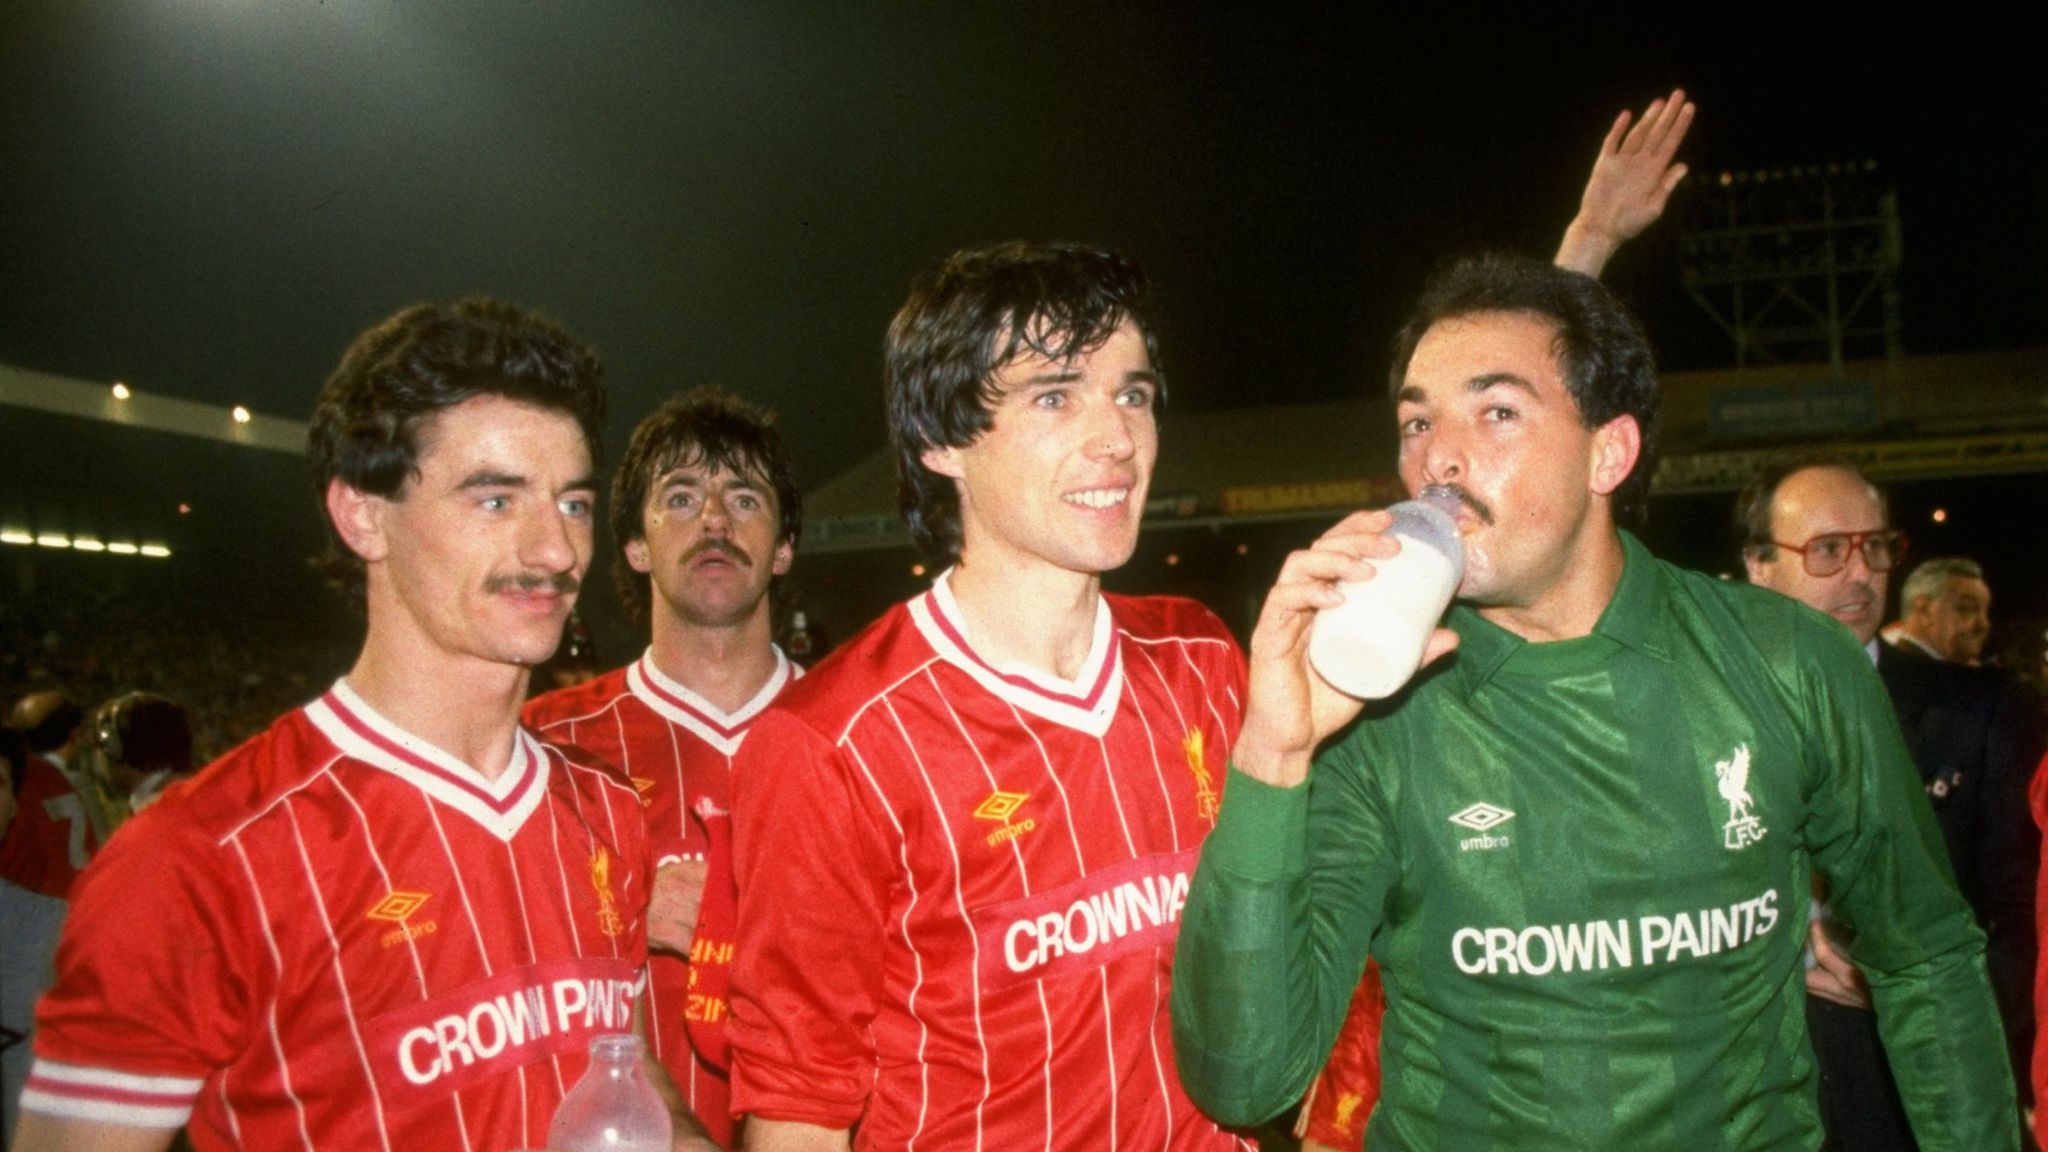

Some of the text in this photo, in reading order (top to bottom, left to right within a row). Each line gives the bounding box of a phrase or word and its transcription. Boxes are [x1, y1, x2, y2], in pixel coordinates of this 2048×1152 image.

[42, 792, 90, 871] 7
[986, 818, 1036, 848] umbro
[1460, 833, 1509, 852] umbro
[381, 920, 438, 949] umbro
[1004, 875, 1162, 973] CROWN
[1451, 888, 1779, 976] CROWN PAINTS
